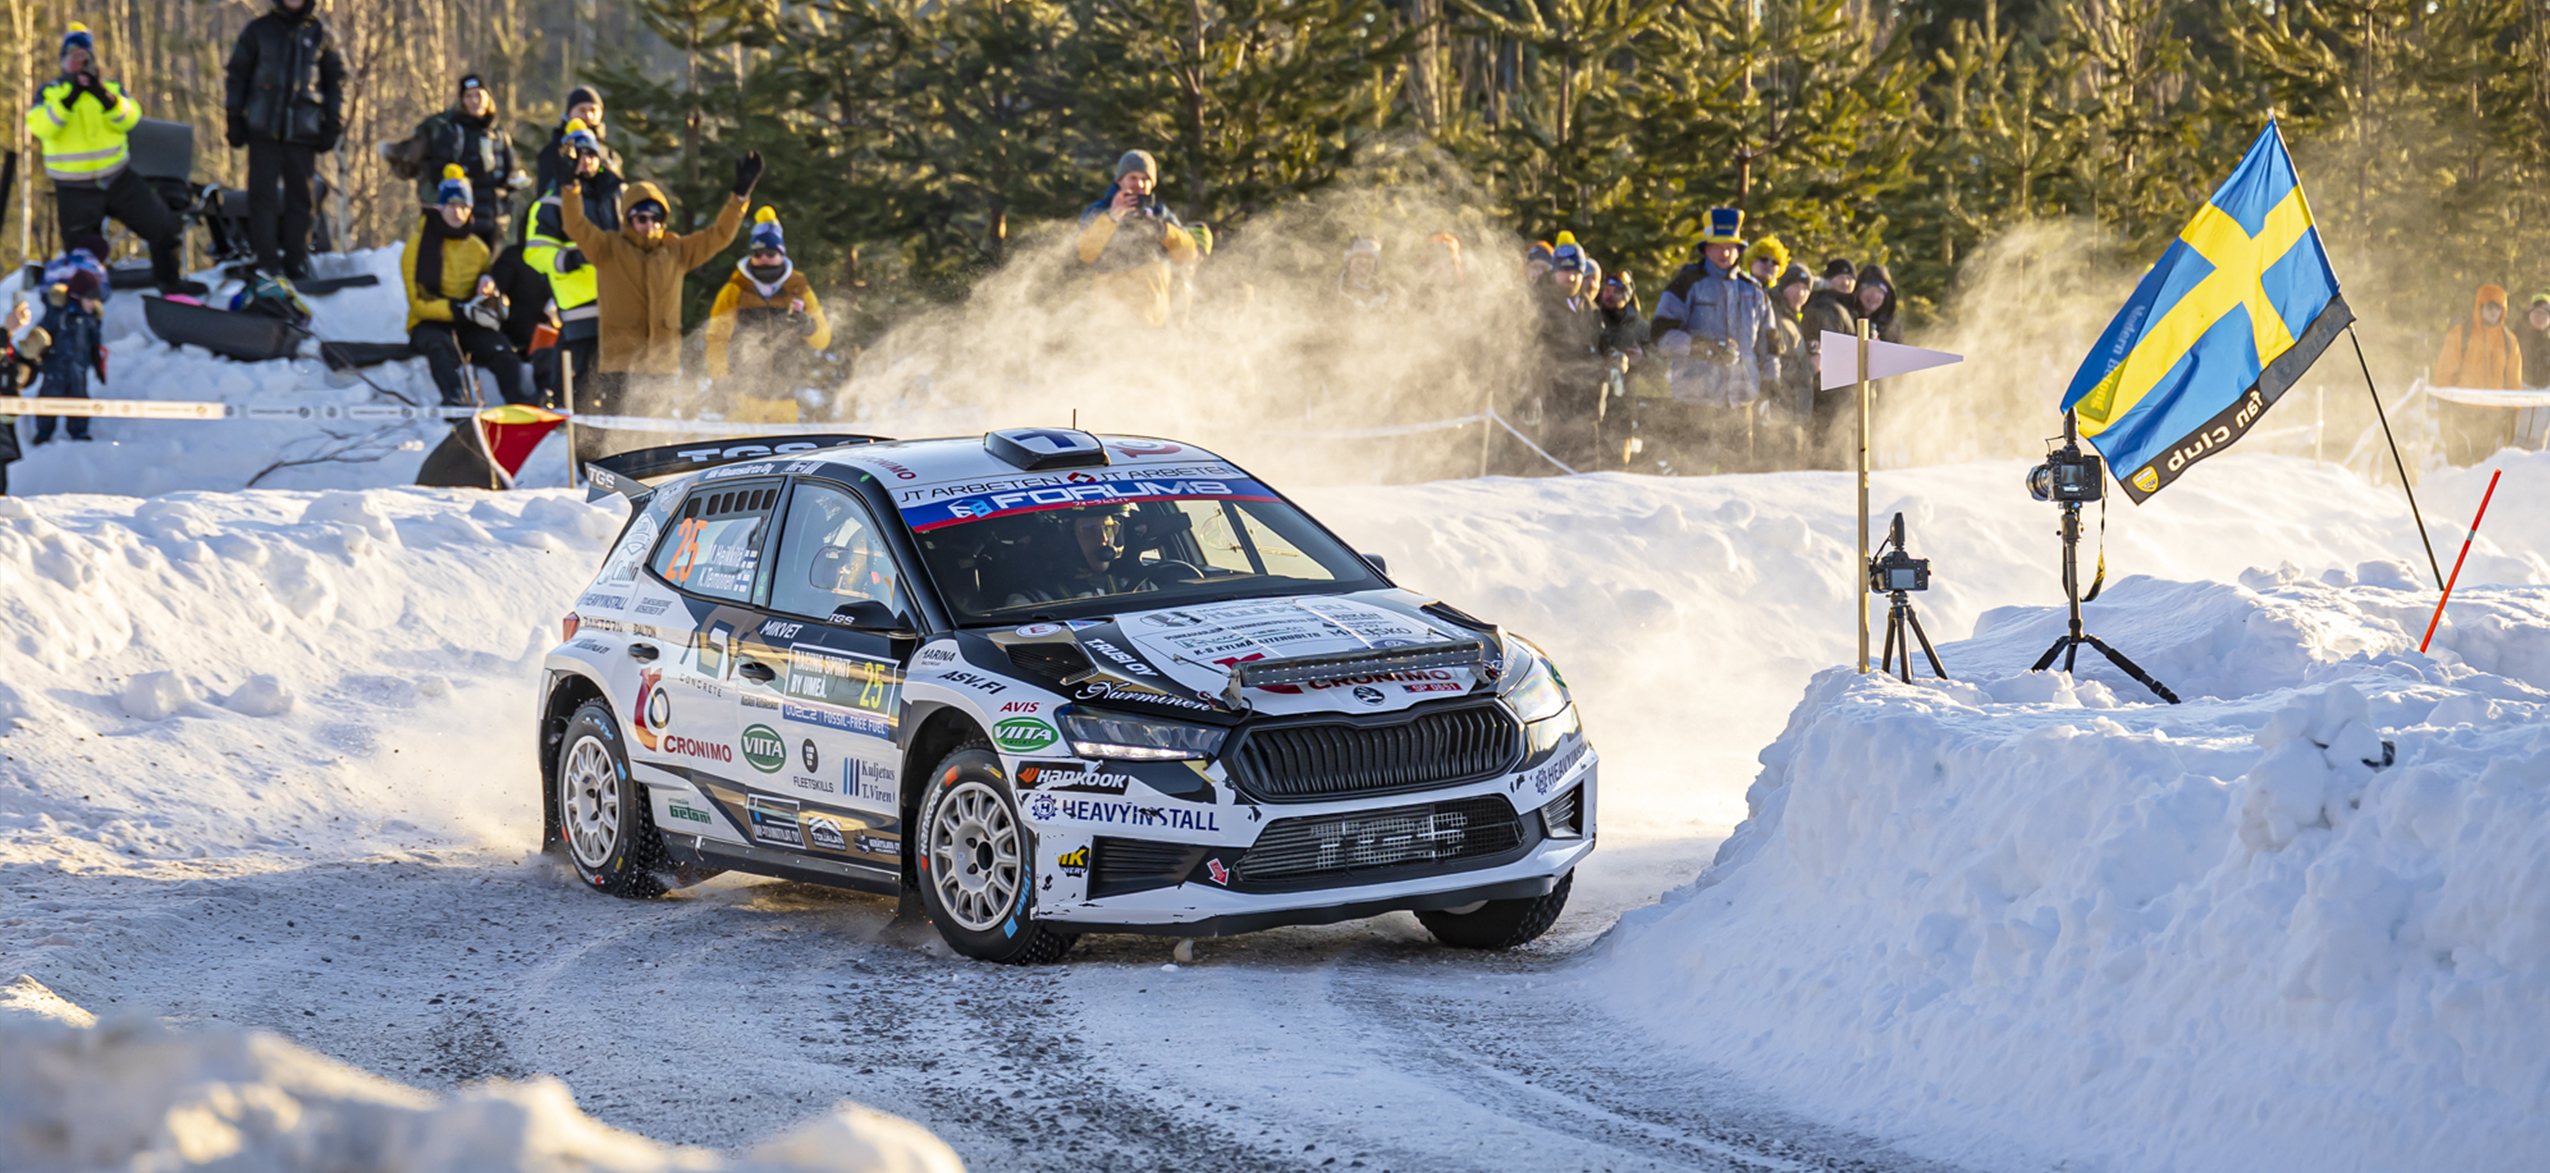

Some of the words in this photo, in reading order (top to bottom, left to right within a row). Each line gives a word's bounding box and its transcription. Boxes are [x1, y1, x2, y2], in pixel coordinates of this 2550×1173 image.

[2113, 304, 2146, 356] Modern
[2089, 357, 2122, 412] Betong
[588, 467, 616, 489] TGS
[1102, 472, 1122, 482] JT
[1129, 466, 1240, 480] ARBETEN
[902, 489, 925, 502] JT
[931, 476, 1062, 498] ARBETEN
[991, 481, 1233, 509] FORUM8
[664, 517, 709, 583] 25
[760, 620, 803, 639] MIKVET
[828, 613, 855, 626] TGS
[1125, 663, 1159, 677] OY
[1307, 669, 1452, 690] CRONIMO
[679, 672, 723, 698] CONCRETE
[790, 673, 804, 694] BY
[859, 661, 886, 709] 25
[937, 670, 1008, 695] ASV.FI
[999, 701, 1040, 713] AVIS
[1074, 680, 1213, 712] Nurminen
[823, 711, 867, 732] FOSSIL-FREE
[868, 719, 886, 735] FUEL
[994, 725, 1053, 742] VIITA
[663, 734, 733, 763] CRONIMO
[742, 735, 785, 759] VIITA
[861, 760, 895, 783] Kuljetus
[793, 775, 835, 793] FLEETSKILLS
[861, 783, 893, 803] T.Viren
[1062, 799, 1220, 832] HEAVYINSTALL
[1310, 812, 1468, 869] TGS
